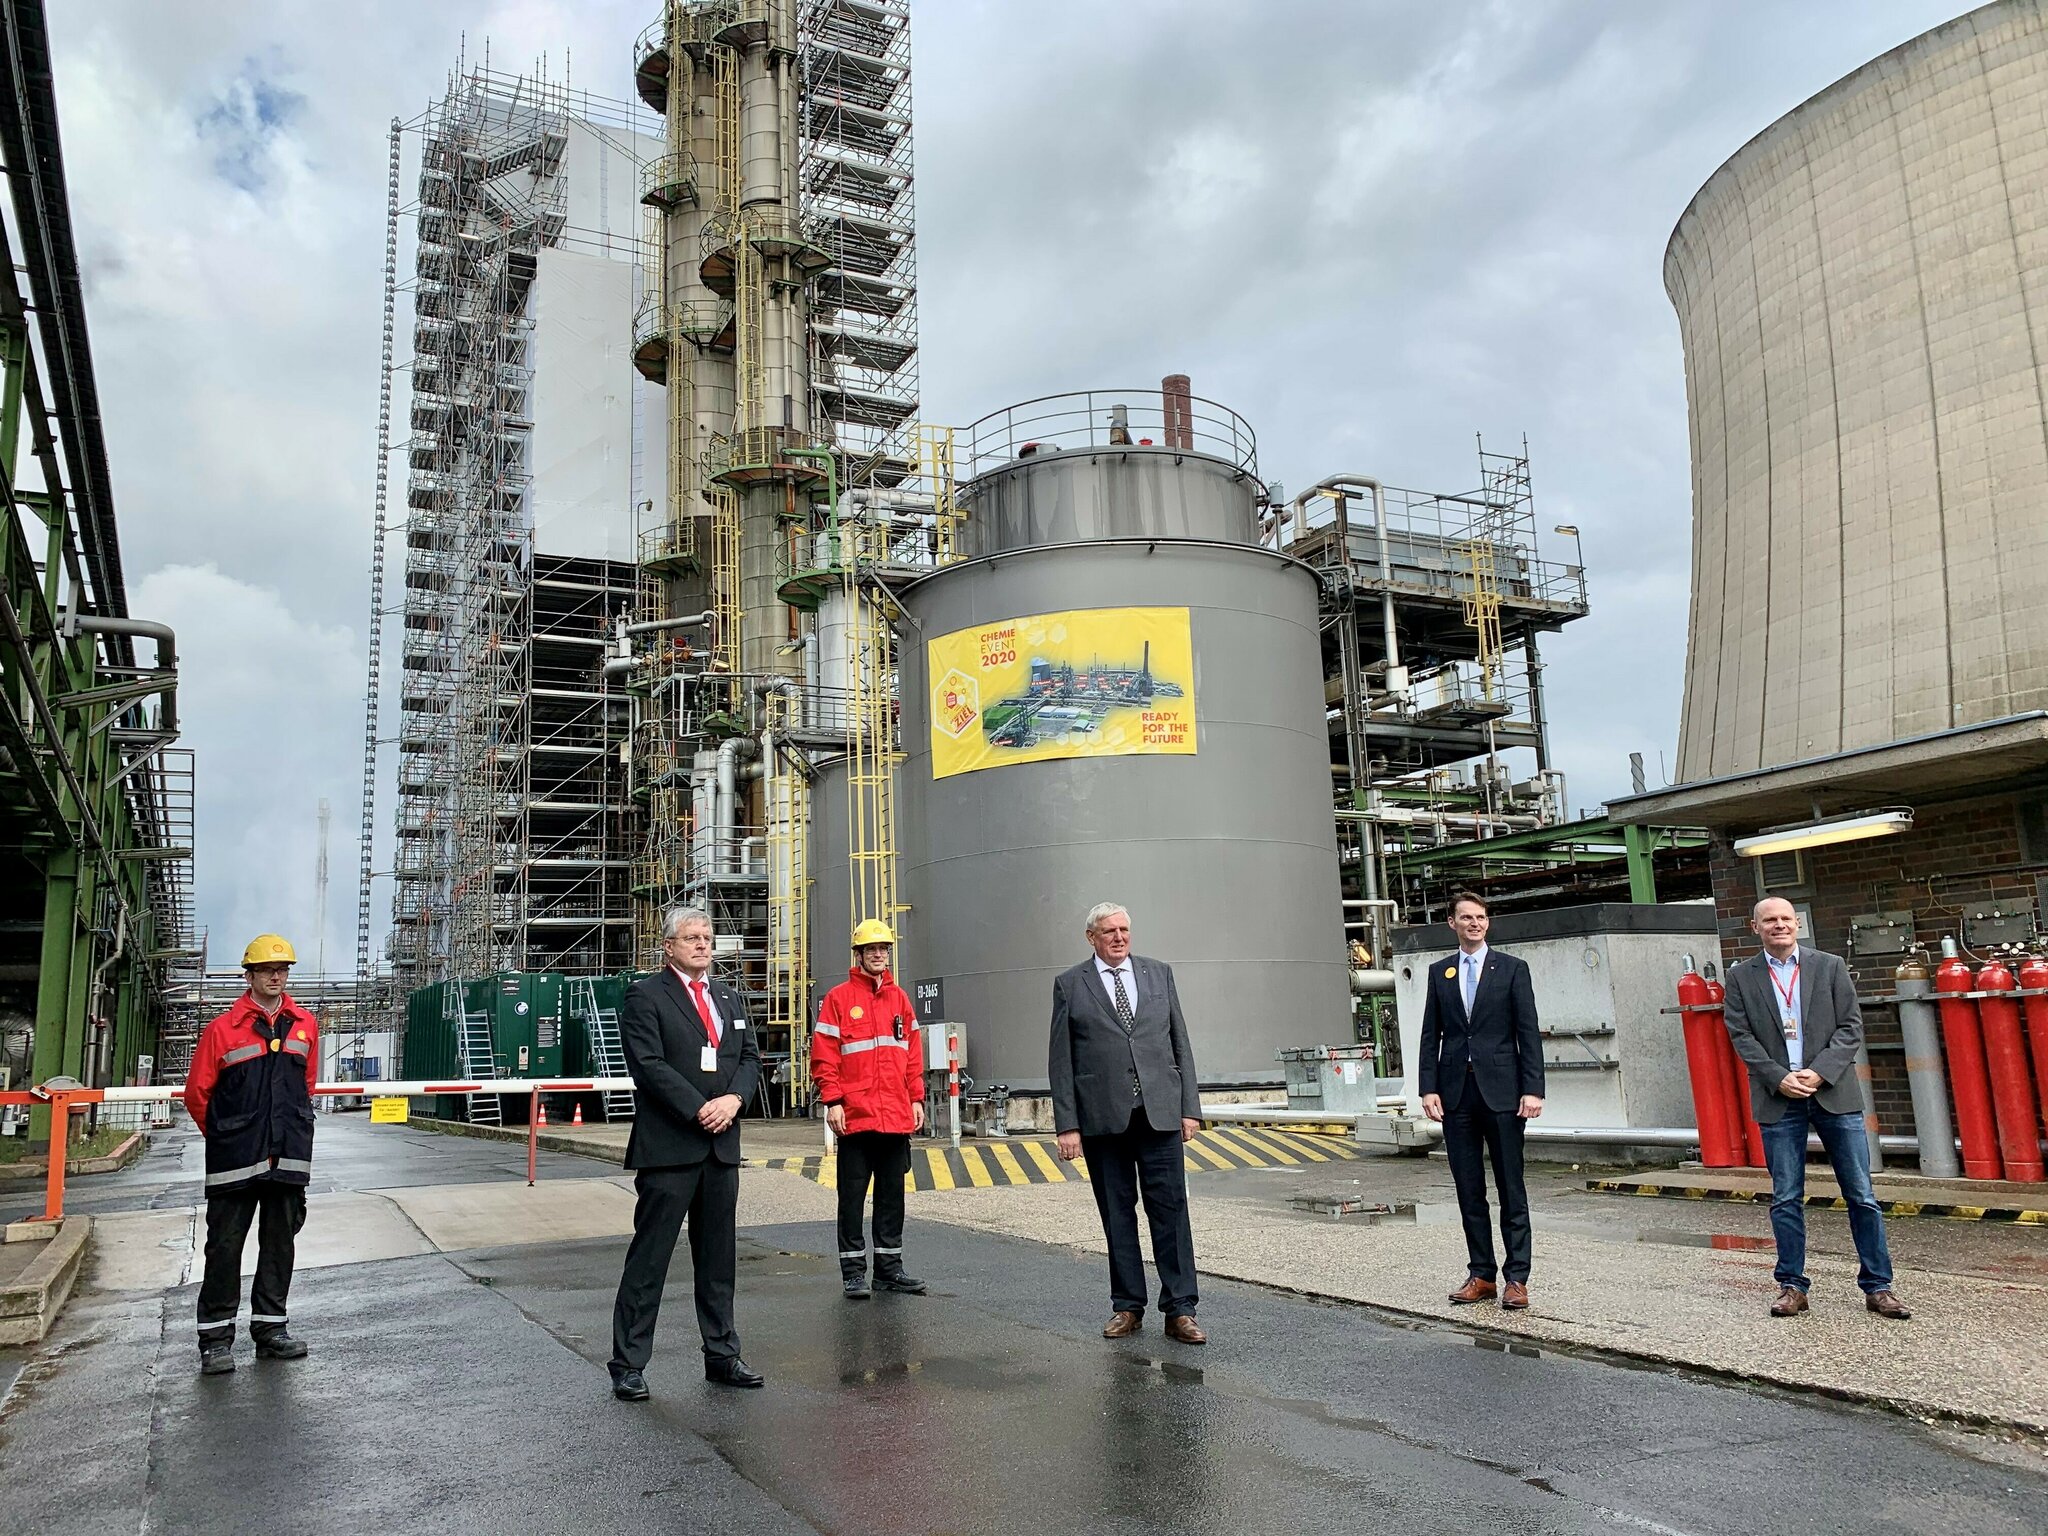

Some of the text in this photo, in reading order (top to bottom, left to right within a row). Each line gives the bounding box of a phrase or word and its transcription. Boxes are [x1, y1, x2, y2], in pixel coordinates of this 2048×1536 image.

[980, 629, 1016, 643] CHEMIE
[980, 638, 1016, 654] EVENT
[981, 650, 1016, 667] 2020
[954, 707, 974, 727] ZIEL
[1142, 712, 1179, 721] READY
[1142, 723, 1188, 733] FOR THE
[1143, 734, 1184, 743] FUTURE
